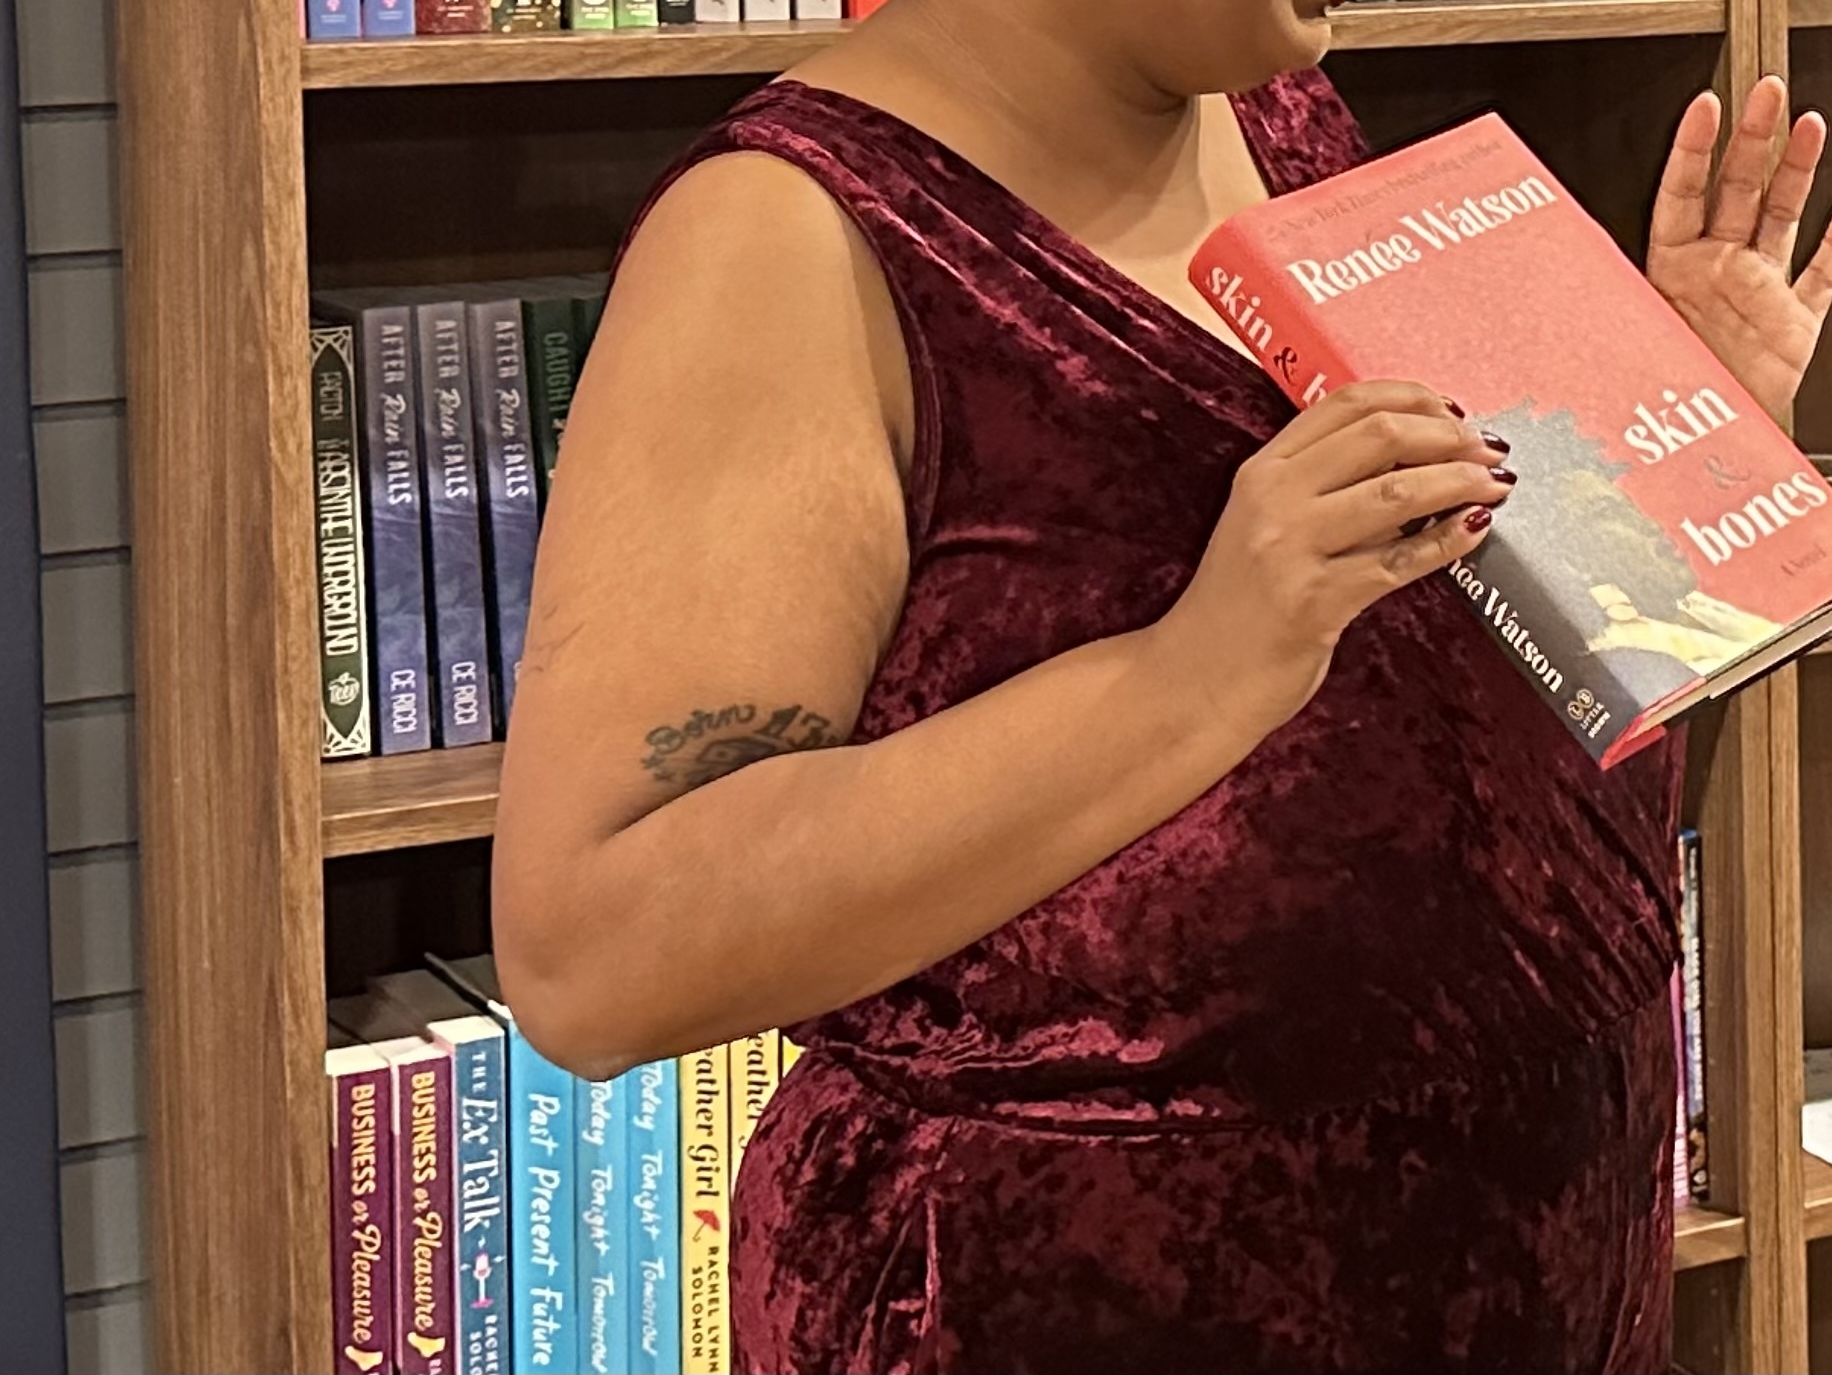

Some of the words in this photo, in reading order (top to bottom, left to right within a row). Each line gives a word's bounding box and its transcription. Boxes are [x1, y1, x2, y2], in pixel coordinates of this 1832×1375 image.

[1398, 175, 1558, 251] Watson
[381, 325, 405, 383] AFTER
[435, 320, 460, 378] AFTER
[495, 321, 520, 378] AFTER
[1206, 266, 1274, 351] skin
[1272, 346, 1298, 386] &
[1623, 387, 1740, 465] skin
[387, 449, 413, 505] FALLS
[441, 443, 469, 499] FALLS
[503, 443, 529, 498] FALLS
[1703, 454, 1752, 491] &
[1680, 471, 1828, 567] bones
[1484, 587, 1564, 693] Watson
[390, 669, 416, 691] CE
[451, 660, 476, 684] CE
[392, 693, 417, 734] RICCI
[473, 1050, 486, 1091] THE
[351, 1083, 376, 1197] BUSINESS
[411, 1071, 437, 1184] BUSINESS
[463, 1095, 498, 1145] Ex
[528, 1093, 561, 1157] Past
[413, 1188, 430, 1211] or
[463, 1149, 500, 1234] Talk
[633, 1149, 663, 1240] Tonight
[687, 1144, 721, 1197] Girl
[352, 1201, 368, 1224] or
[528, 1165, 562, 1277] Present
[352, 1225, 382, 1344] Pleasure
[413, 1211, 442, 1330] Pleasure
[708, 1246, 720, 1317] RACHEL
[530, 1286, 563, 1366] Future
[692, 1266, 704, 1358] SOLOMON
[708, 1325, 720, 1373] LYNN
